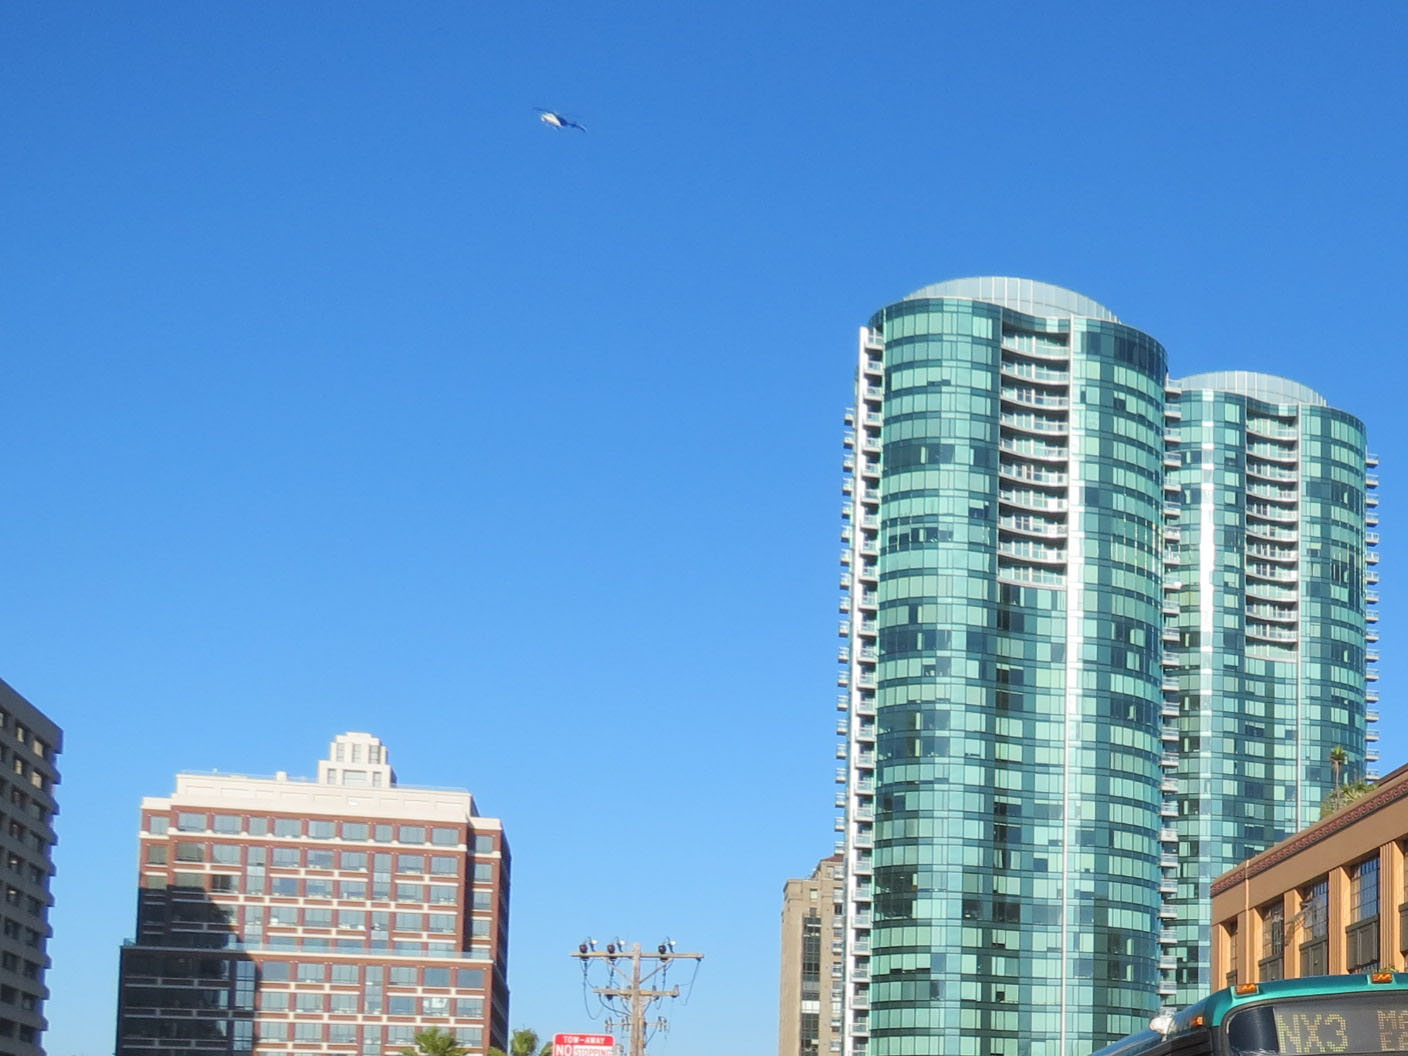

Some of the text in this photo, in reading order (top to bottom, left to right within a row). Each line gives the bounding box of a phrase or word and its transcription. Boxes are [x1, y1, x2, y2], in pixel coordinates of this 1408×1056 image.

[1276, 1013, 1349, 1054] NX3
[563, 1036, 605, 1045] TOW-AWAY
[556, 1045, 573, 1056] NO
